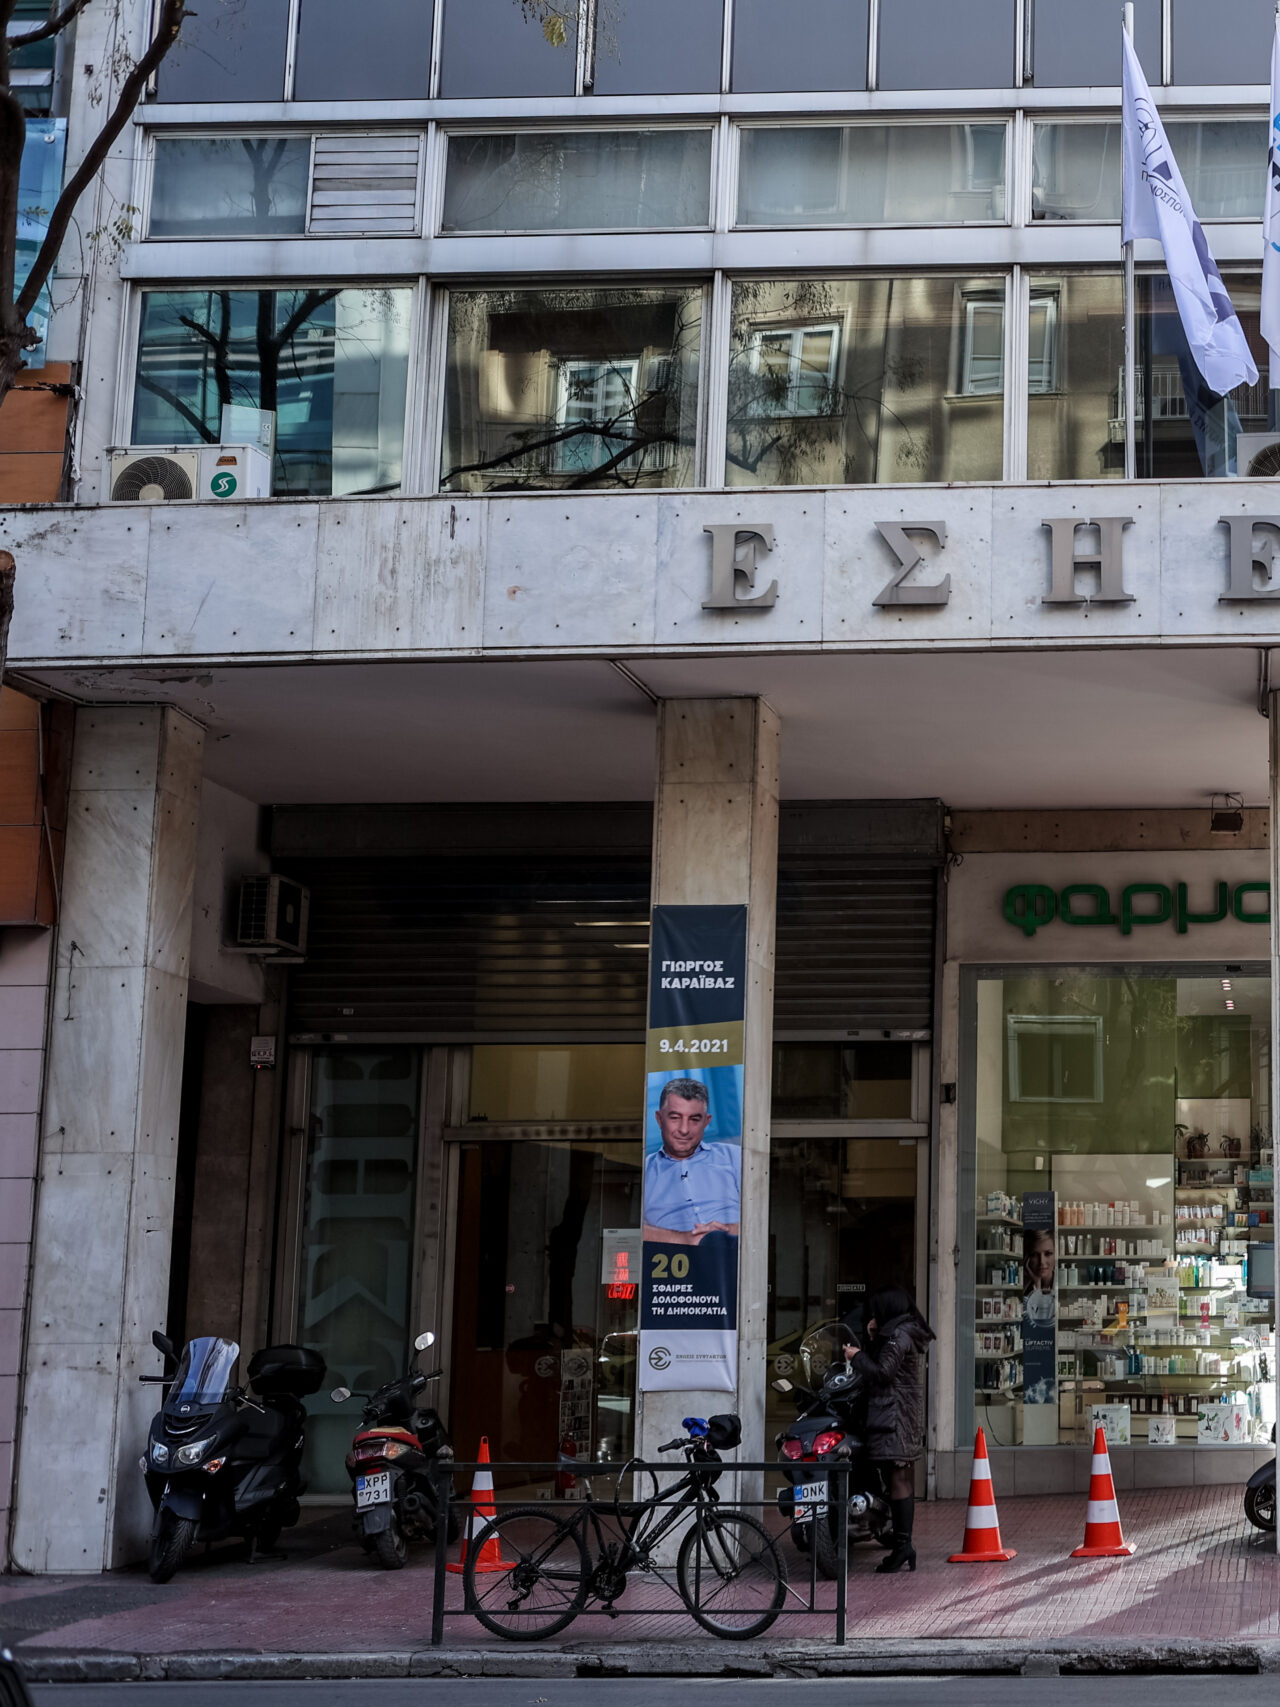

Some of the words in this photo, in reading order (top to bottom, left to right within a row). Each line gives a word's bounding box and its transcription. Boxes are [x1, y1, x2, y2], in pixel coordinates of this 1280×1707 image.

[661, 961, 724, 972] ΓΙΩΡΓΟΣ
[661, 975, 735, 989] ΚΑΡΑΪΒΑΖ
[659, 1039, 729, 1053] 9.4.2021
[651, 1253, 690, 1278] 20
[652, 1284, 693, 1293] ΣΦΑΙΡΕΣ
[652, 1295, 720, 1304] ΔΟΛΟΦΟΝΟΥΝ
[652, 1307, 664, 1315] ΤΗ
[666, 1307, 728, 1315] ΔΗΜΟΚΡΑΤΙΑ
[365, 1489, 388, 1502] 731
